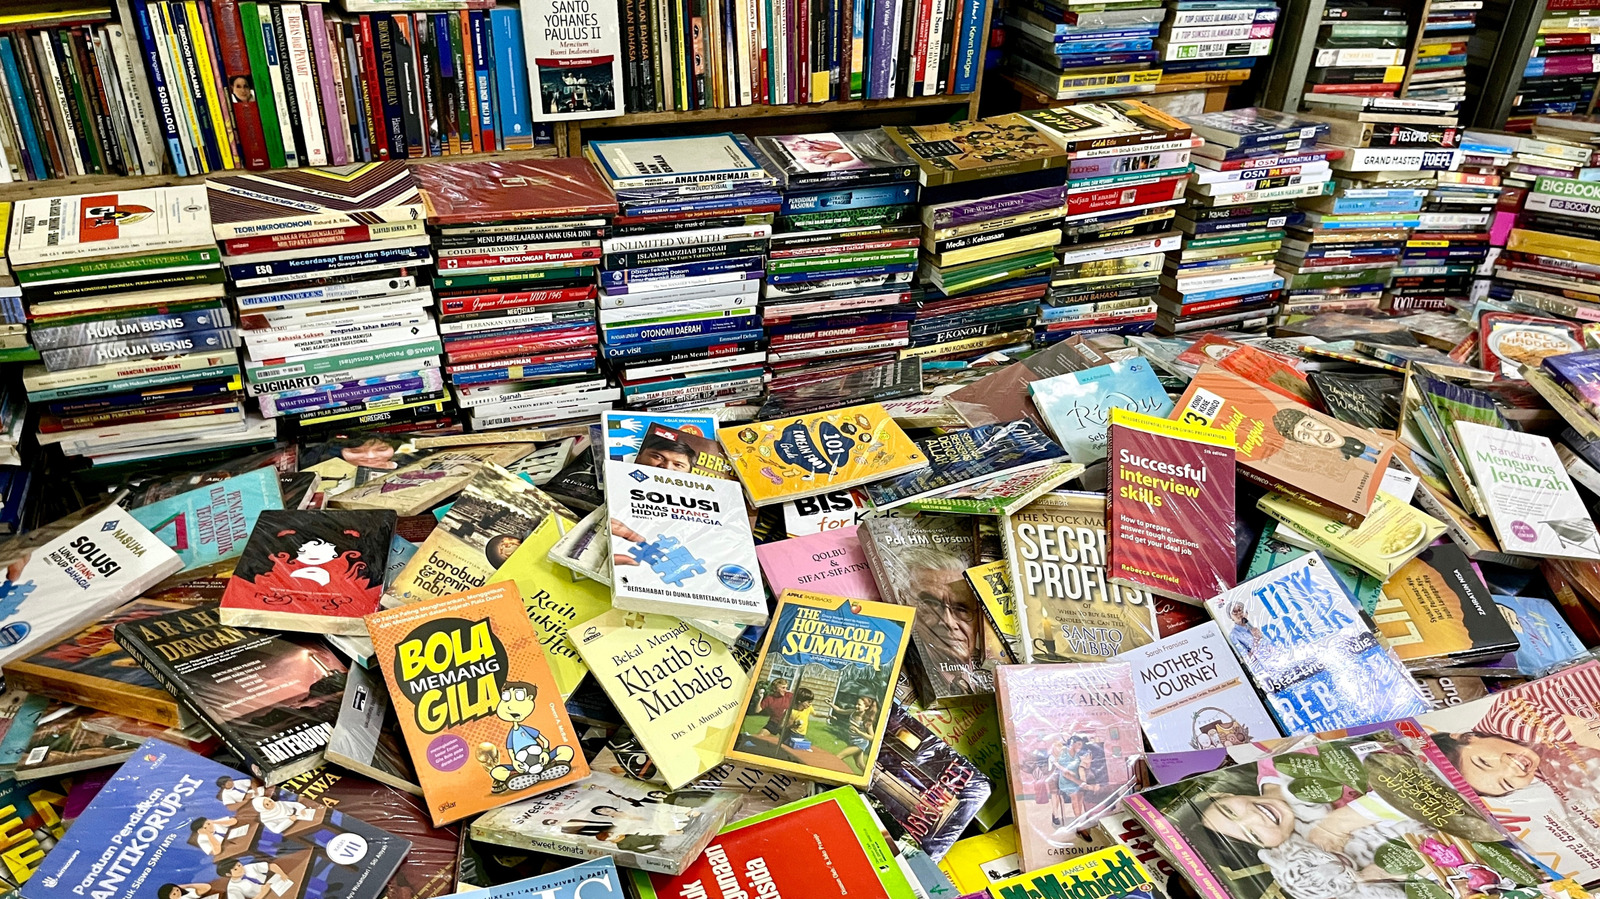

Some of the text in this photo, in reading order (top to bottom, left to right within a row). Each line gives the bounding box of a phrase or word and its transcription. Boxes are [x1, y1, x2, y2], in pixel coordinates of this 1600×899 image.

[552, 1, 589, 14] SANTO
[544, 14, 598, 27] YOHANES
[545, 27, 601, 40] PAULUS II
[627, 25, 636, 62] BAHASA
[964, 26, 977, 79] Kevin Bridges
[150, 52, 176, 134] Pengantar SOSIOLOGI
[1364, 153, 1452, 168] GRAND MASTER TOEFL
[675, 172, 750, 184] ANAK DAN REMAJA
[1259, 179, 1271, 188] IPA
[1541, 180, 1564, 193] BIG
[964, 199, 1024, 215] THE WHOLE INTERNET
[1069, 192, 1119, 205] Sofjan Wanandi
[447, 247, 477, 256] COLOR
[479, 245, 520, 254] HARMONY
[612, 234, 720, 252] UNLIMITED WEALTH
[946, 240, 966, 250] Media
[972, 232, 1005, 244] Kekuasaan
[80, 263, 108, 272] ISLAM
[142, 255, 192, 266] UNIVERSAL
[256, 247, 413, 275] ESQ Kecerdasan Emosi dan Spiritual
[499, 252, 574, 264] PERTOLONGAN PERTAMA
[1065, 291, 1119, 304] JALAN BAHASA
[86, 318, 184, 340] HUKUM BISNIS
[277, 321, 402, 342] Rahasia Sukses Pengusaha Tahan Banting
[467, 317, 530, 329] PERBANKAN SYARIAH
[641, 325, 702, 339] OTONOMI DAERAH
[936, 324, 989, 344] EKONOMI
[96, 340, 194, 360] HUKUM BISNIS
[609, 346, 642, 357] Our visit
[670, 346, 746, 361] Jalan Menuju Stabilitas
[117, 364, 181, 377] FINANCIAL MANAGEMENT
[453, 358, 532, 372] ESENSI KEPEMIMPINAN
[253, 376, 320, 395] SUGIHARTO
[1190, 395, 1204, 410] KONO
[1198, 399, 1211, 414] KENE
[1205, 399, 1220, 418] KONCO
[823, 433, 846, 455] 101
[925, 440, 950, 465] ALLAH
[938, 436, 960, 463] DENGAN
[1212, 450, 1228, 458] edition
[1490, 444, 1539, 462] Panduan
[1120, 449, 1207, 482] Successful
[1476, 450, 1557, 475] Mengurus
[654, 474, 715, 493] NASUHA
[1120, 465, 1200, 499] interview
[1490, 465, 1569, 492] Jenazah
[630, 489, 721, 514] SOLUSI
[1120, 485, 1163, 508] skills
[226, 490, 249, 542] PENGANTAR
[631, 502, 710, 519] LUNAS UTANG
[631, 509, 723, 528] HIDUP BAHAGIA
[210, 486, 235, 556] ILMU MENDIDIK
[817, 516, 851, 532] for
[1271, 510, 1331, 548] THE BEST Chicken Soup
[112, 528, 149, 559] NASUHA
[1120, 524, 1200, 549] answer tough questions
[58, 545, 97, 581] LUNAS UTANG
[70, 535, 123, 578] SOLUSI
[812, 547, 847, 562] QOLBU
[830, 559, 840, 568] &
[48, 552, 92, 592] HIDUP BAHAGIA
[1121, 564, 1180, 584] Rebecca Corfield
[412, 576, 443, 596] nabi
[1453, 568, 1487, 616] ZAHRATUN NISA
[372, 586, 507, 625] 50 Fakta Paling Mengherankan, Menggelikan,
[531, 588, 577, 621] Raih
[797, 607, 822, 620] THE
[156, 625, 247, 663] DENGAN
[612, 621, 691, 667] Bekal Menjadi
[1061, 625, 1123, 643] SANTO
[398, 621, 497, 682] BOLA
[782, 632, 883, 672] SUMMER
[1068, 639, 1121, 657] VIBBY
[1145, 639, 1190, 659] Sarah Fransisca
[615, 633, 713, 698] Khatib &
[1140, 646, 1214, 686] MOTHER'S
[409, 659, 501, 695] MEMANG
[1153, 663, 1220, 701] JOURNEY
[417, 673, 499, 733] GILA
[637, 665, 733, 723] Mubalig
[256, 723, 310, 747] STEPHEN
[260, 722, 335, 765] ARTERBURN
[1378, 775, 1449, 828] SIAP-SIAP
[1571, 804, 1600, 829] takut
[73, 787, 165, 896] Panduan Pendidikan
[90, 774, 204, 899] ANTIKORUPSI
[340, 841, 362, 859] VII
[531, 839, 584, 855] sweet sonata
[1545, 825, 1600, 870] brand new
[132, 833, 178, 892] Siswa SMP/MTs
[1061, 860, 1099, 877] JAMES LEE
